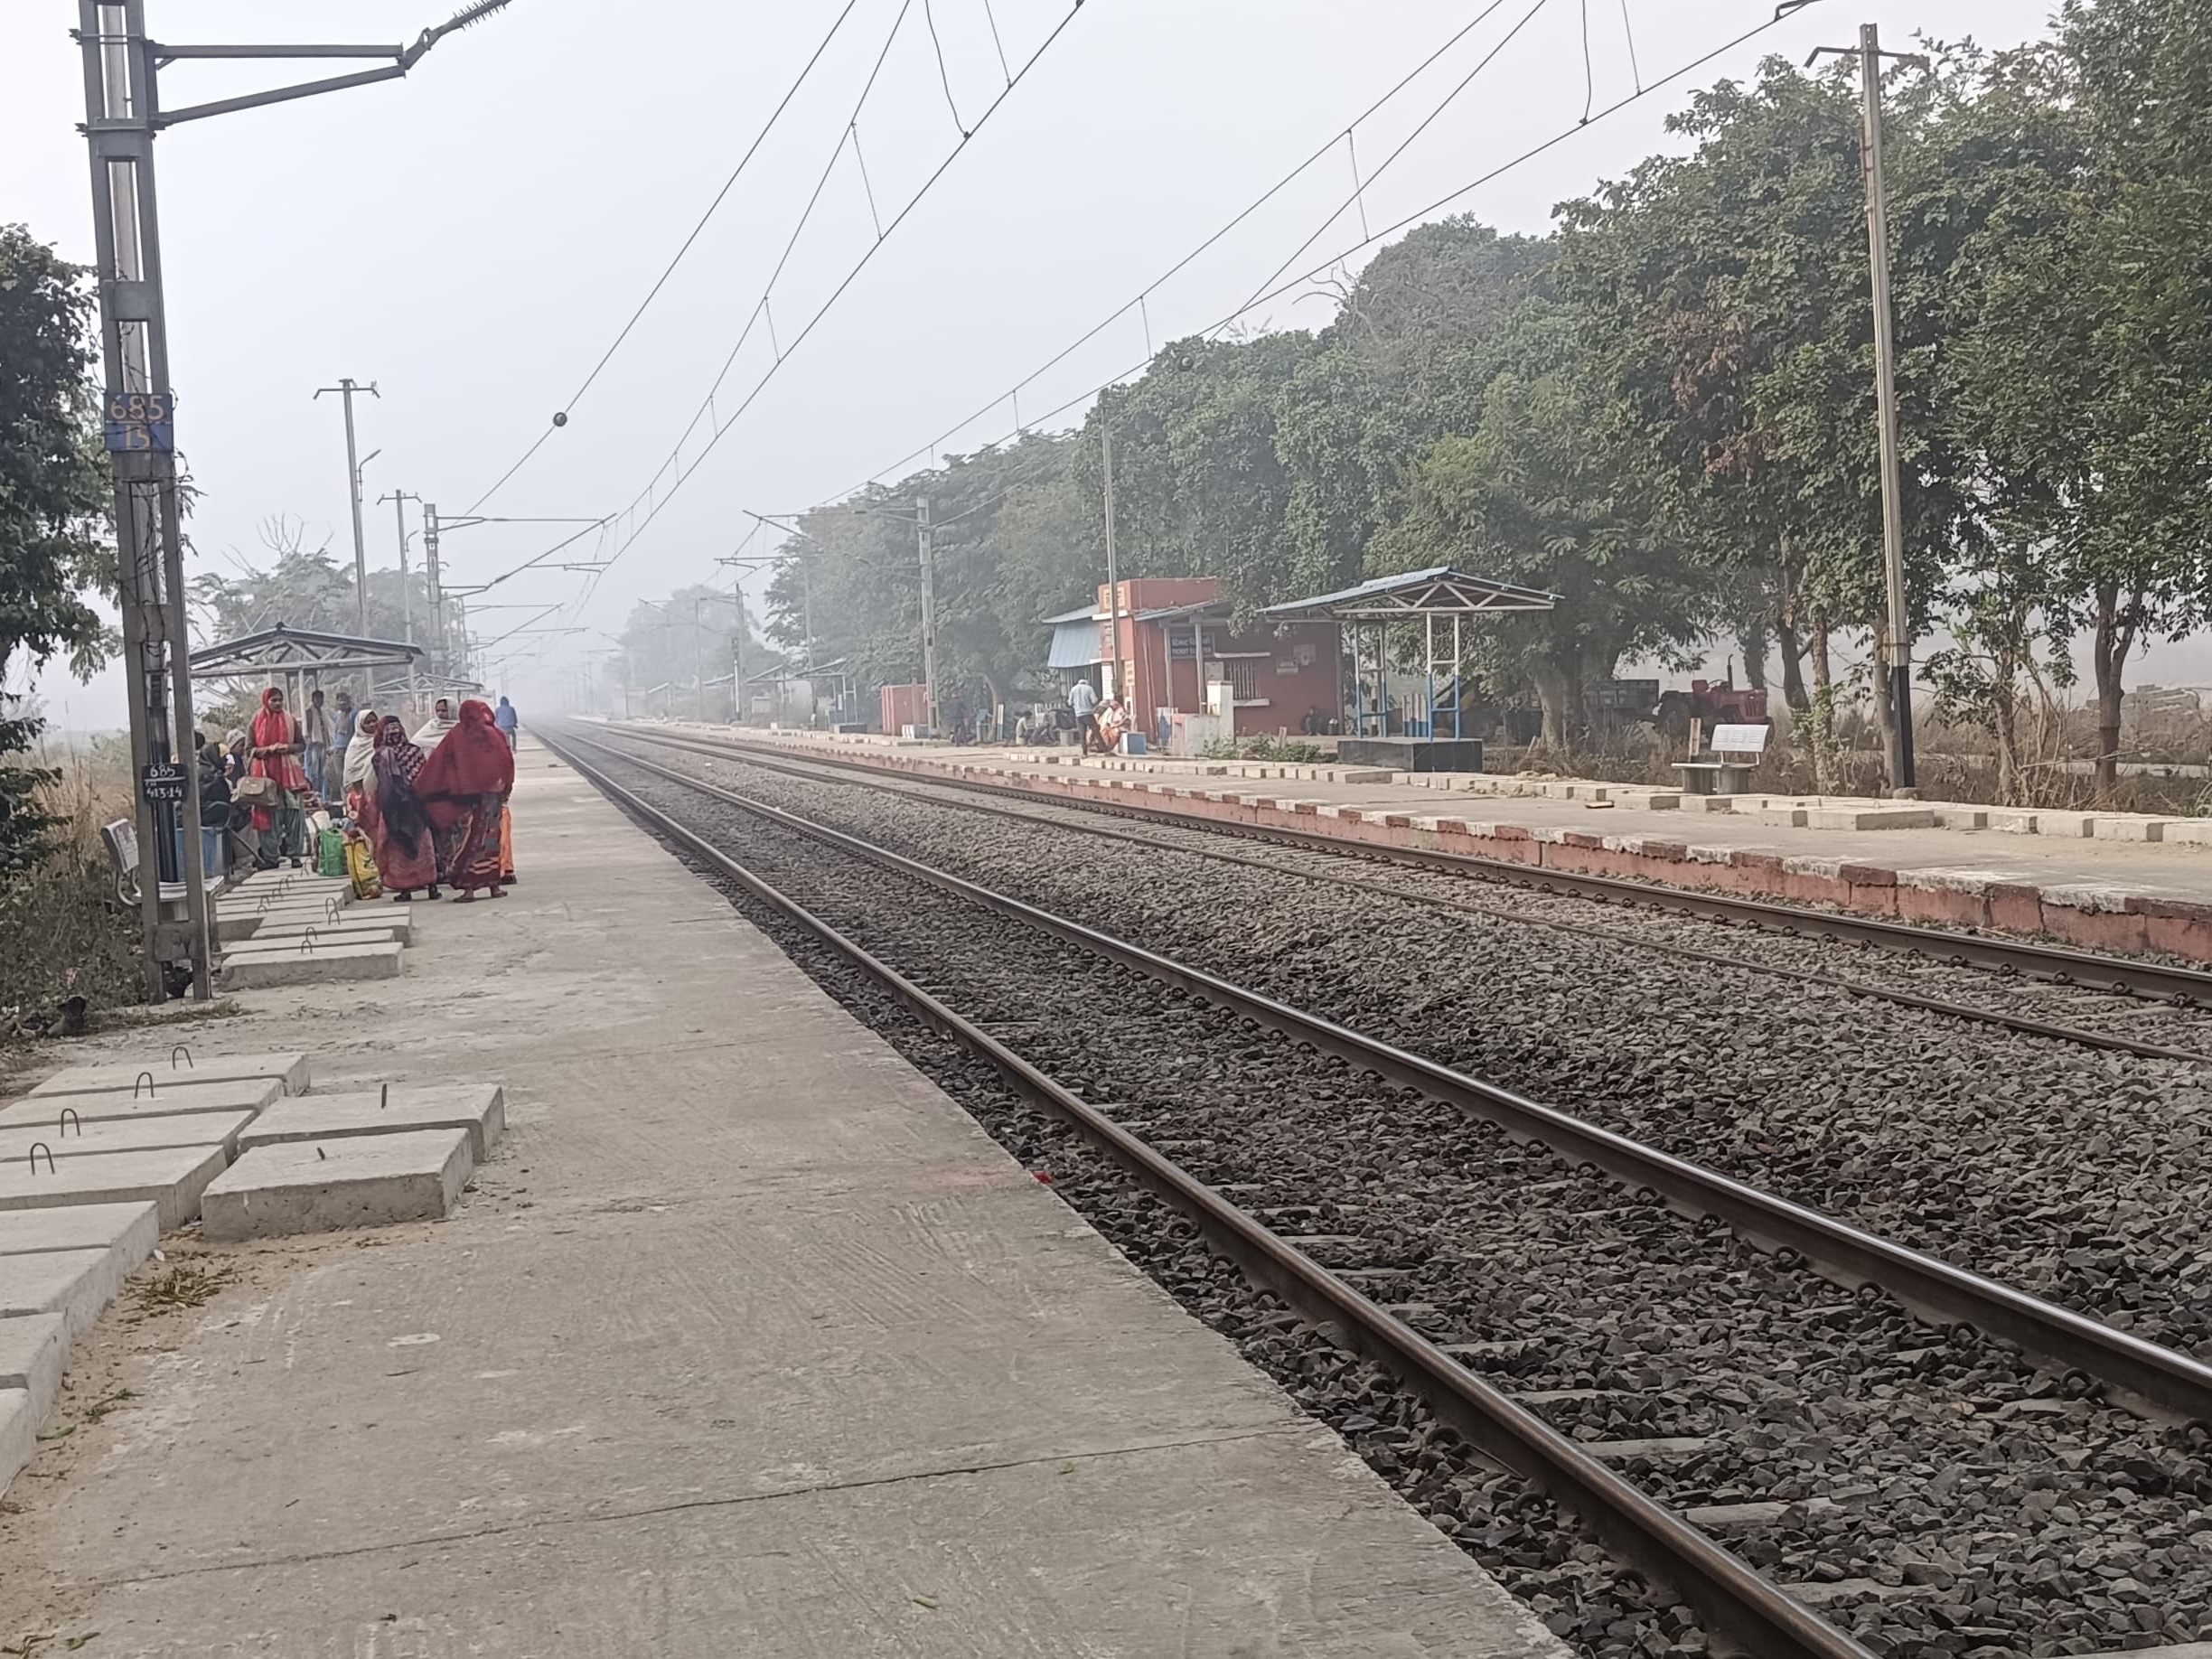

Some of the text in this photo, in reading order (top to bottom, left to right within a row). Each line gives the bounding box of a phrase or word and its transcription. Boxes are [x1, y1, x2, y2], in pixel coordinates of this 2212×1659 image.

[110, 394, 164, 420] 685
[126, 424, 151, 450] 15
[150, 764, 175, 778] 685
